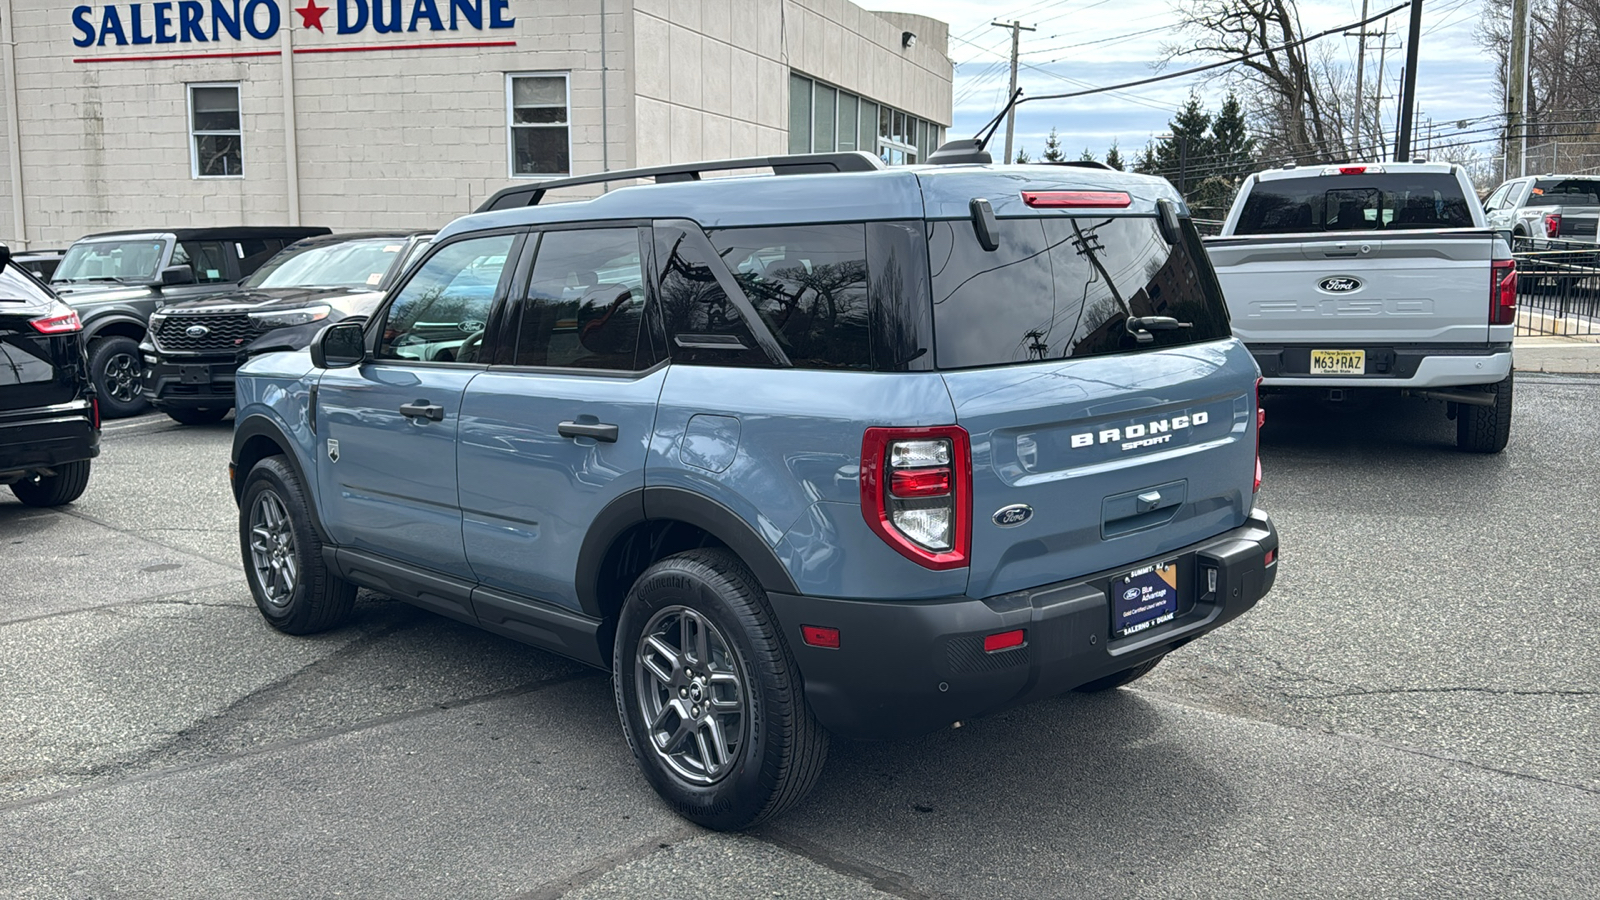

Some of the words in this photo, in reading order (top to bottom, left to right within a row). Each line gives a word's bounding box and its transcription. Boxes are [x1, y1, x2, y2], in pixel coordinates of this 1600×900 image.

[71, 0, 281, 48] SALERNO
[336, 0, 516, 35] DUANE
[1325, 278, 1354, 291] Ford
[1248, 298, 1434, 316] F-150
[463, 321, 482, 332] Ford
[1070, 411, 1209, 448] BRONCO
[1121, 434, 1173, 451] SPORT
[1003, 508, 1026, 523] Ford
[636, 575, 685, 602] Continental
[1141, 586, 1153, 595] Blue
[1141, 589, 1167, 602] Advantage
[1123, 622, 1150, 635] SALERNO
[1156, 612, 1175, 625] DUANE
